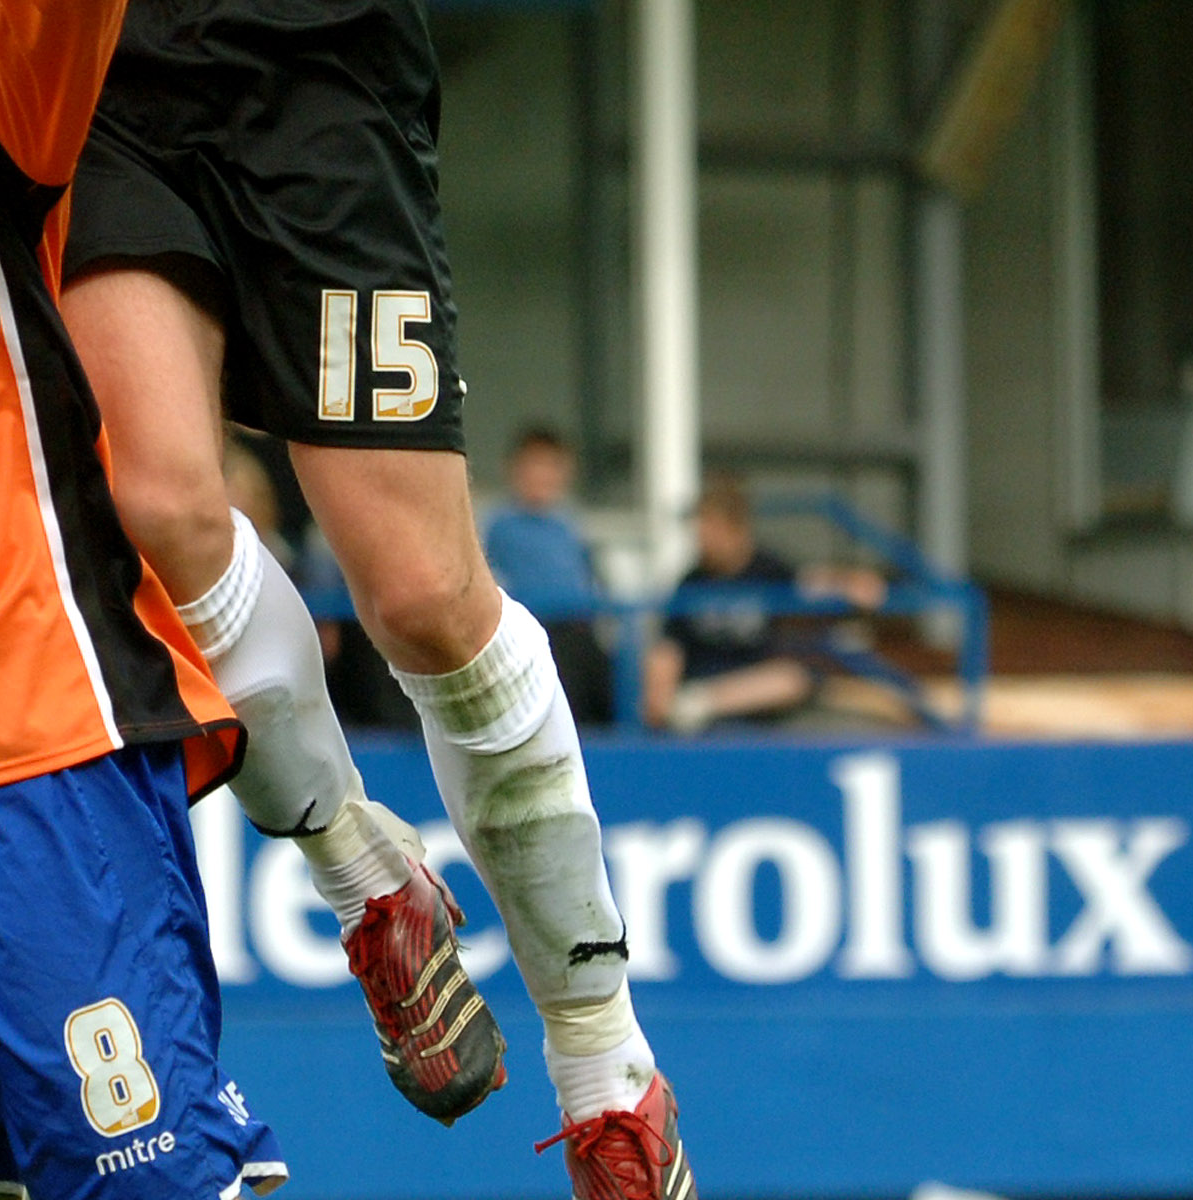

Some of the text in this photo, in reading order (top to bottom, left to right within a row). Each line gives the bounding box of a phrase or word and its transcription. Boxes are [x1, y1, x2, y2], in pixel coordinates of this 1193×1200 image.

[318, 289, 439, 421] 15
[64, 997, 160, 1138] 8
[95, 1131, 176, 1176] mitre
